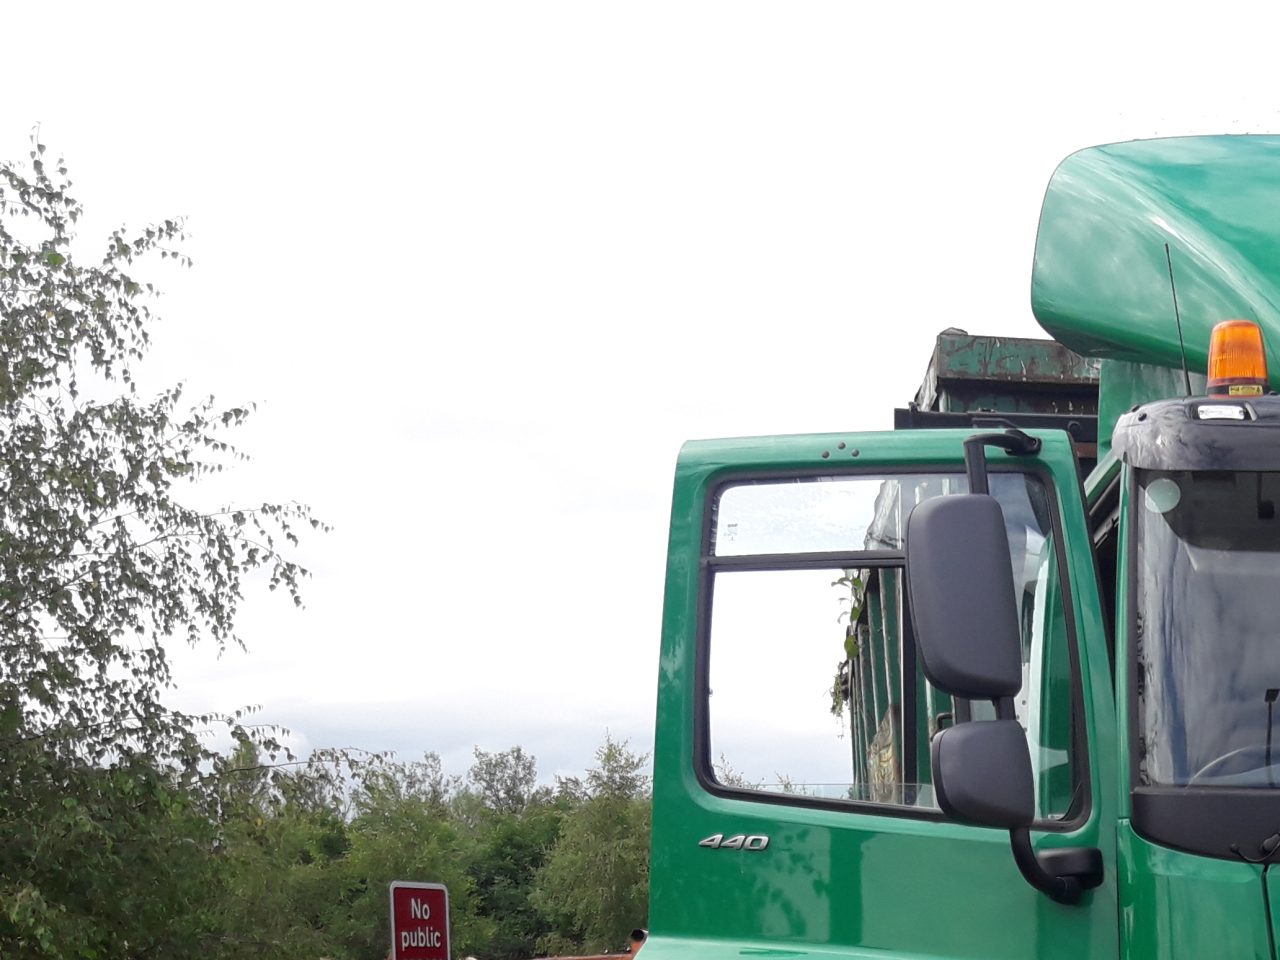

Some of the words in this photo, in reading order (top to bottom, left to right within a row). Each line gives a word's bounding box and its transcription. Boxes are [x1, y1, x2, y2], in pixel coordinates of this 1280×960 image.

[698, 833, 769, 850] 440
[411, 898, 430, 920] No
[401, 926, 441, 951] public
